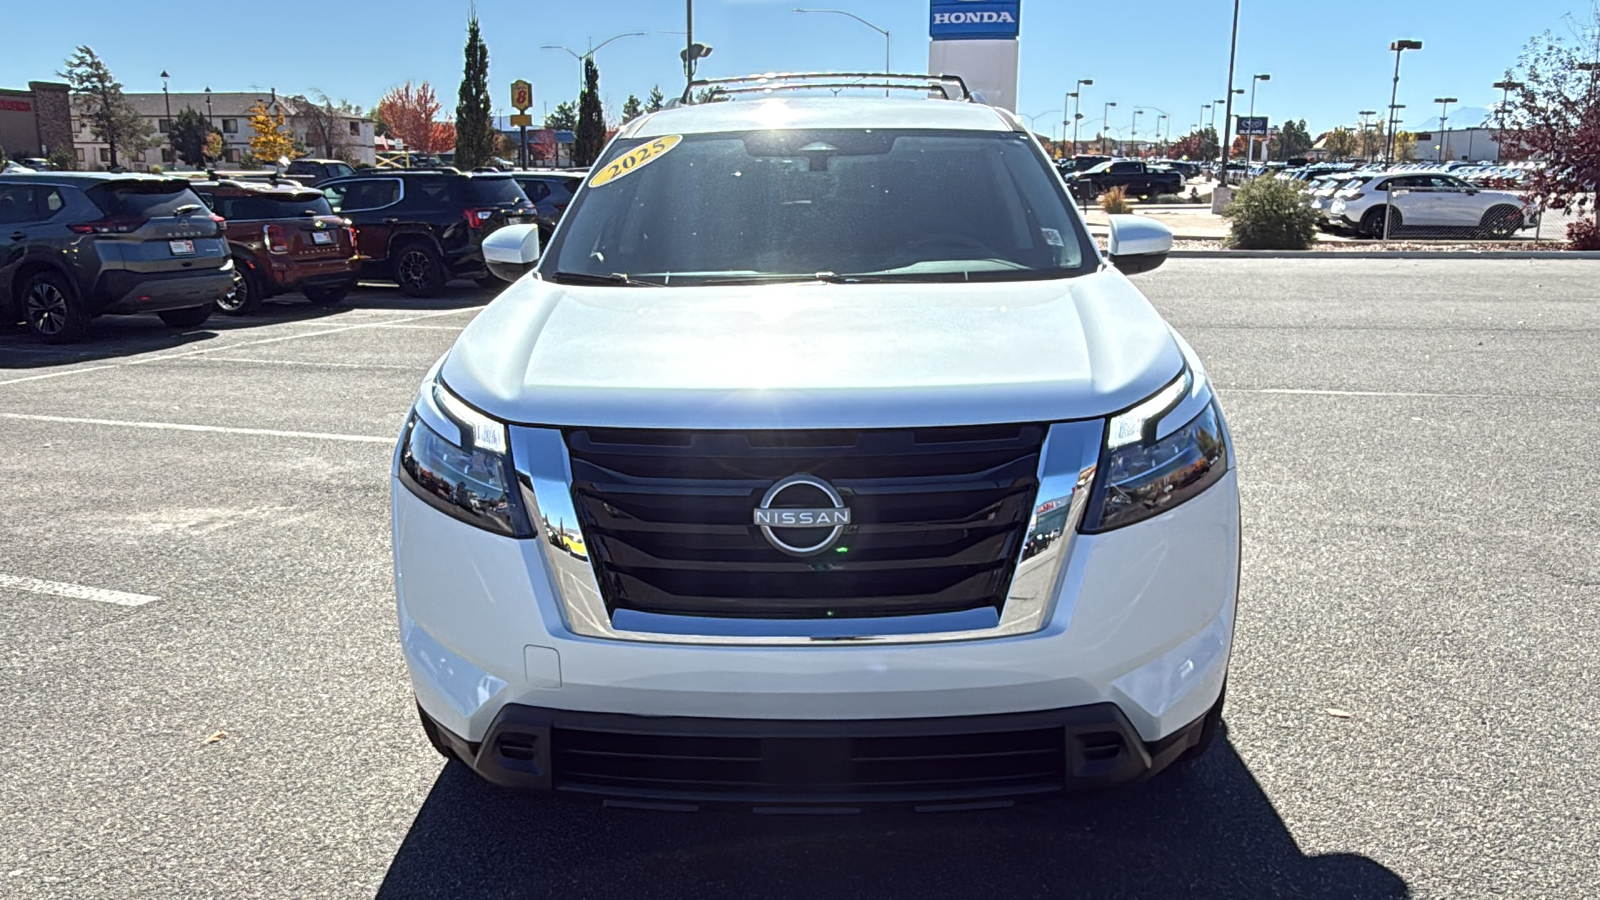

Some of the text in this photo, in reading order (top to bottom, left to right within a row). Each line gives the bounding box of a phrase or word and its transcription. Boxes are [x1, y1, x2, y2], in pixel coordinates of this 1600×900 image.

[933, 11, 1015, 24] HONDA
[516, 90, 527, 104] 8
[608, 140, 666, 179] 2025
[756, 511, 848, 524] NISSAN
